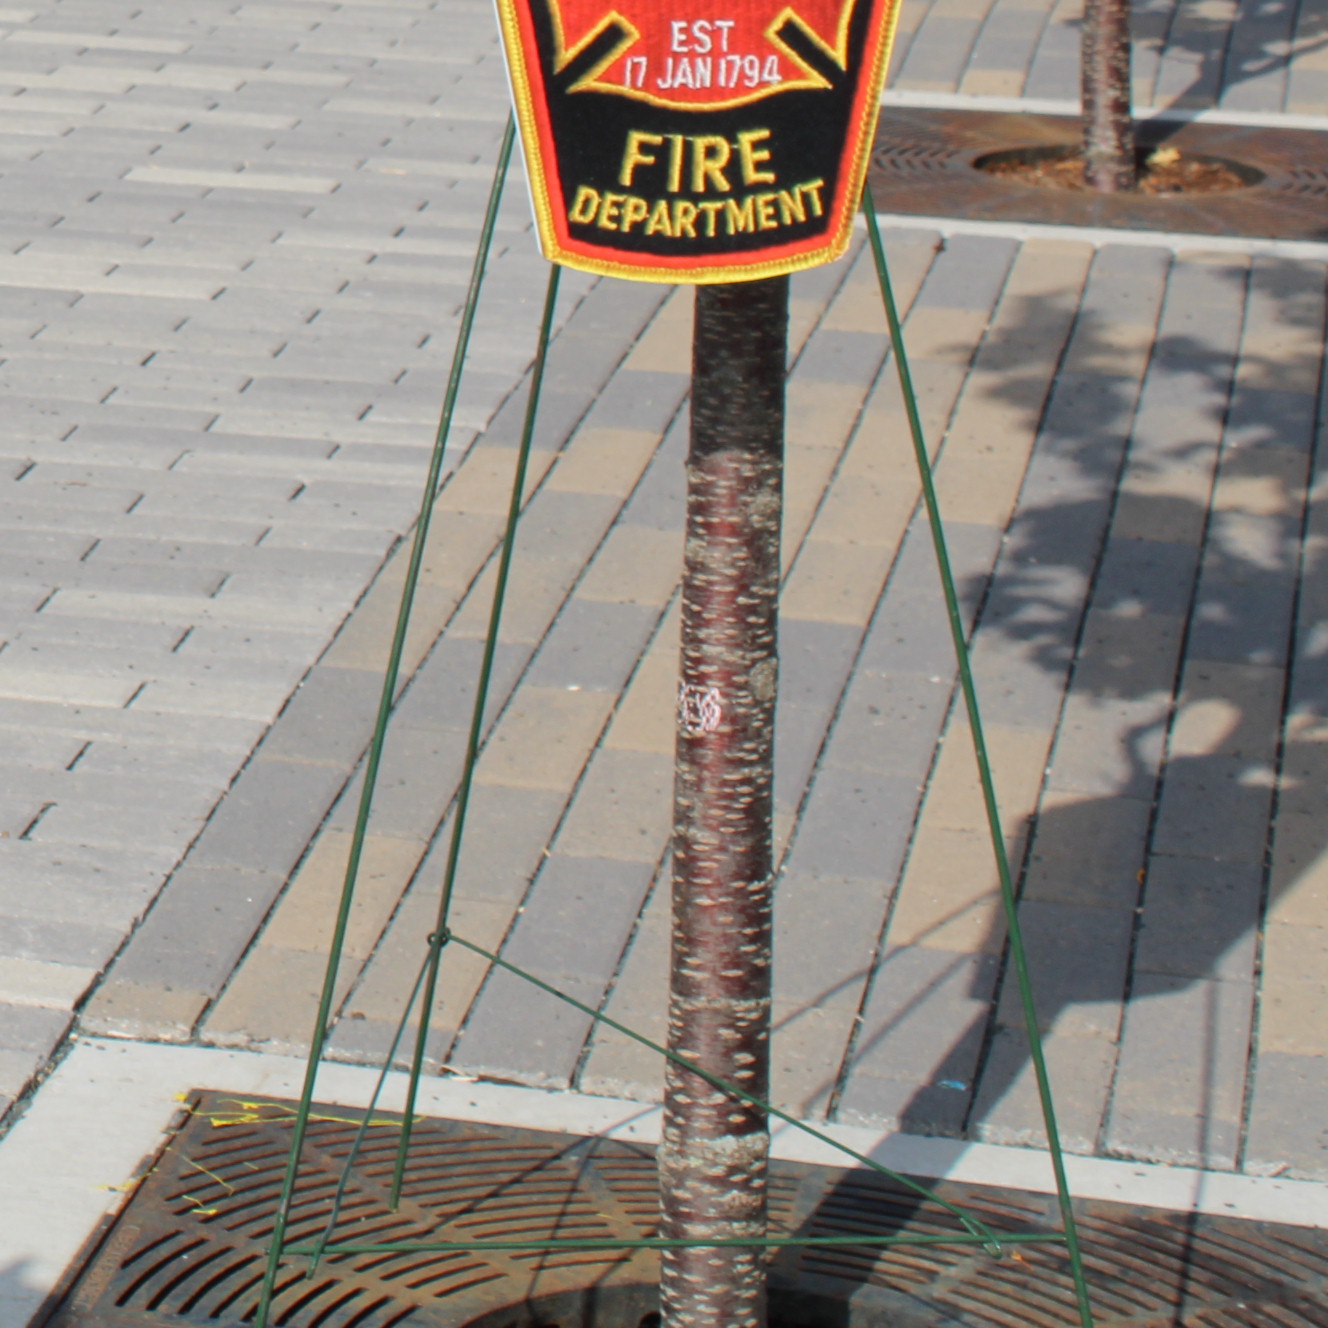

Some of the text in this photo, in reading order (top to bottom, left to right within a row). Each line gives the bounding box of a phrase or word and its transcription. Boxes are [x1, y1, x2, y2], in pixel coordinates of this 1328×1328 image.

[671, 20, 734, 54] EST
[624, 55, 782, 89] 17 JAN 1794
[618, 128, 776, 193] FIRE
[568, 177, 825, 238] DEPARTMENT
